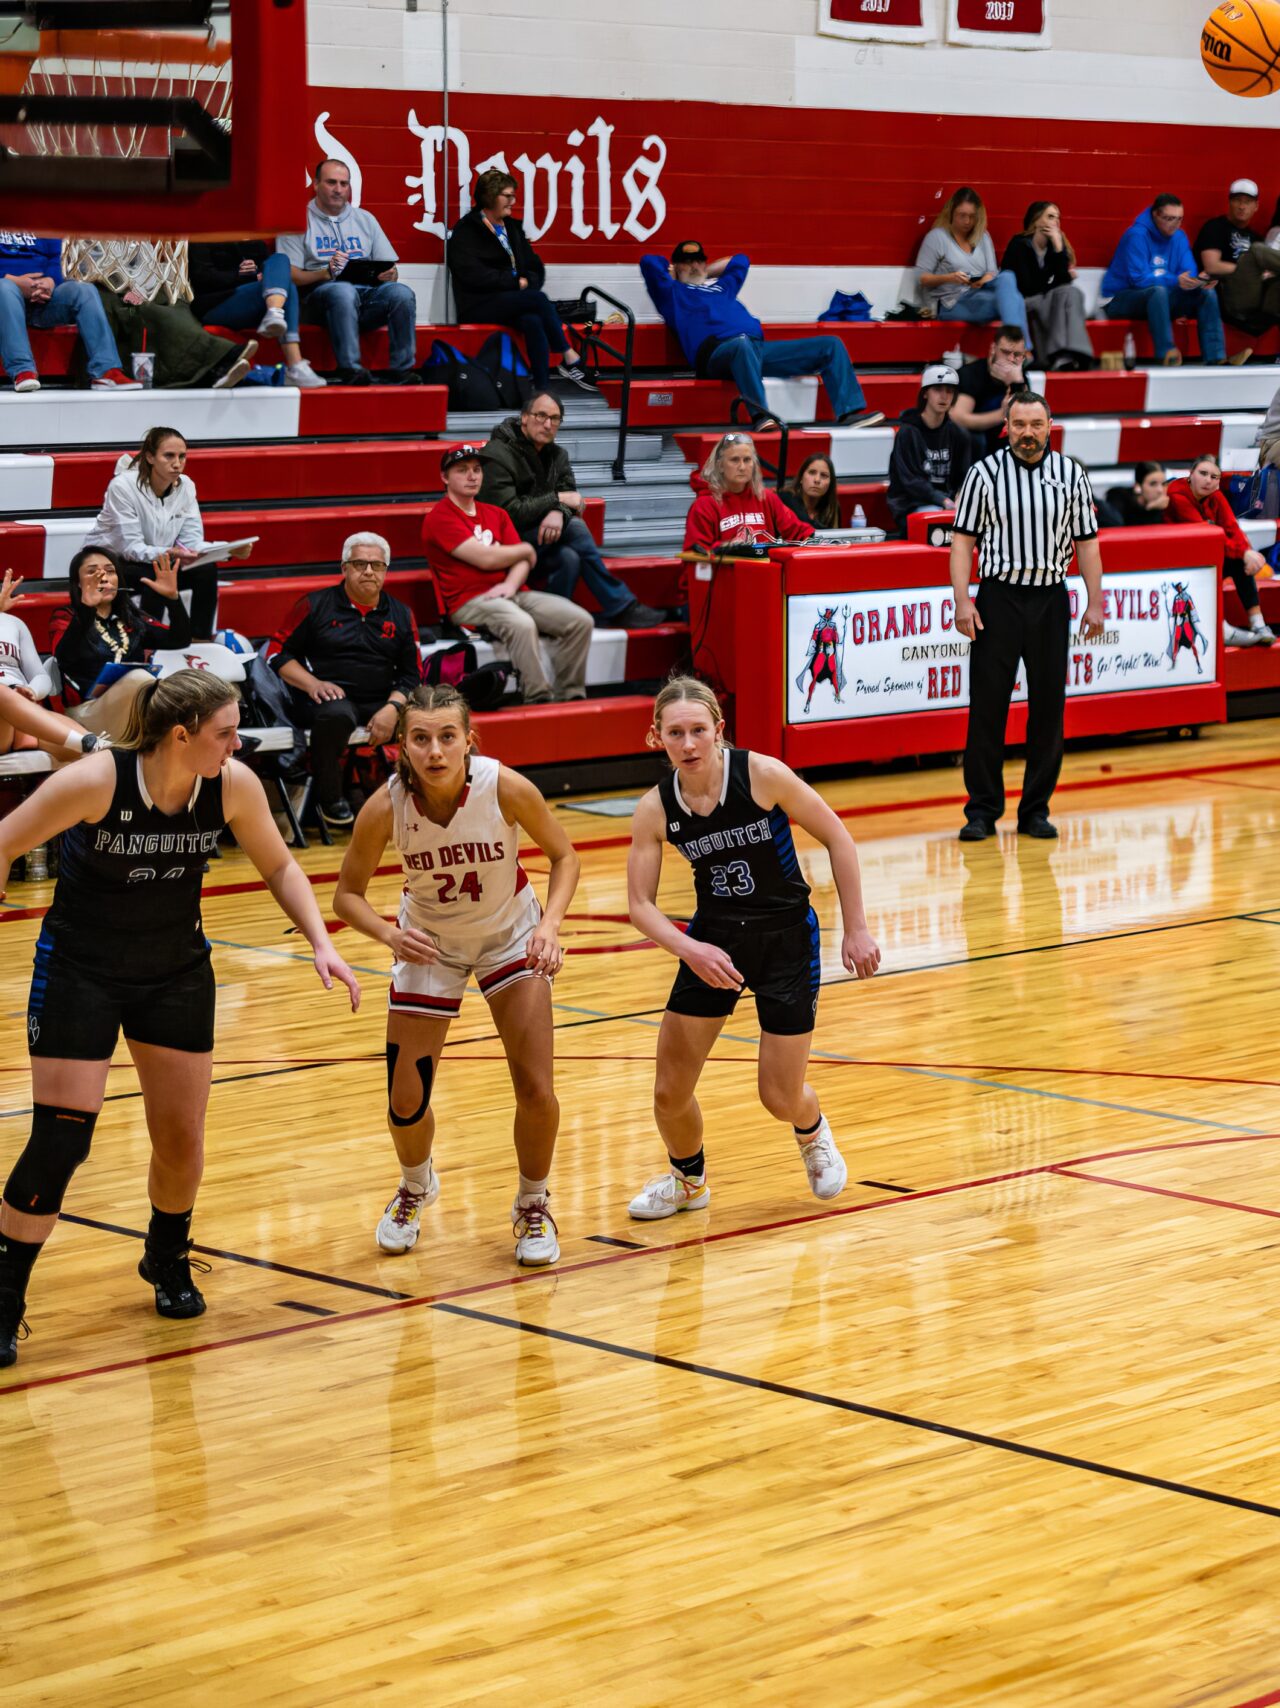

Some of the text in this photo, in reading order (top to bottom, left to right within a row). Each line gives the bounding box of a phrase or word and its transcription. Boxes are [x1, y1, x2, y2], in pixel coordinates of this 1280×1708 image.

[405, 108, 668, 242] Dvils
[852, 601, 931, 646] GRAND
[1102, 588, 1160, 622] EVILS
[901, 642, 971, 662] CANYONL
[927, 664, 962, 701] RED
[403, 841, 505, 871] RED DEVILS
[432, 870, 483, 904] 24
[710, 860, 755, 897] 23
